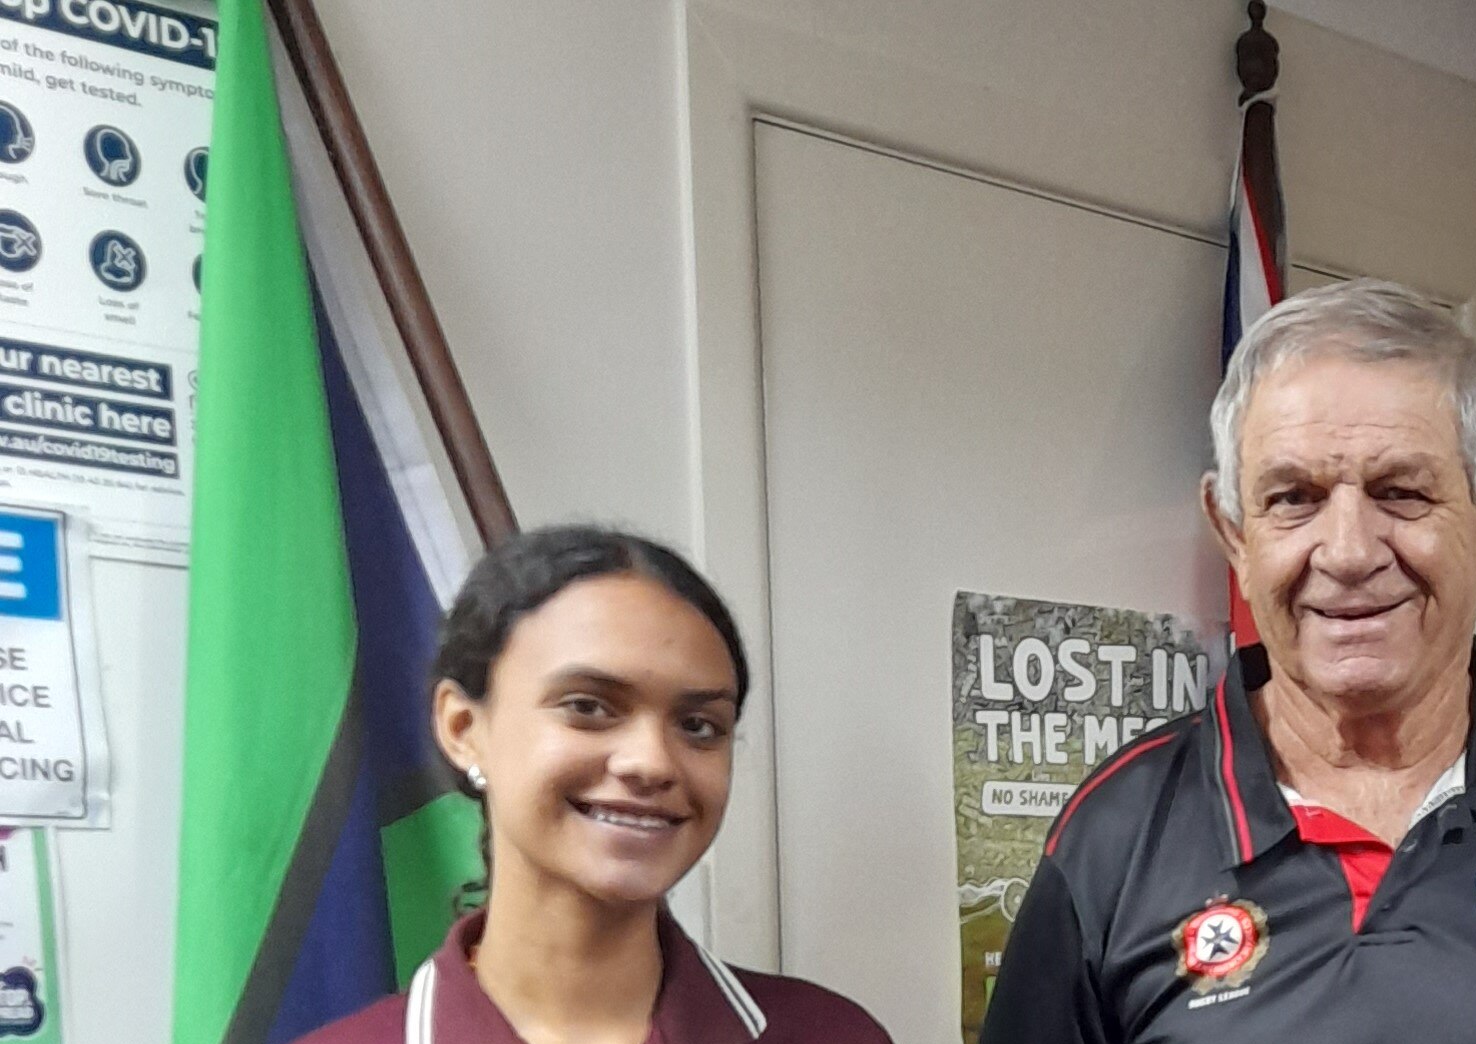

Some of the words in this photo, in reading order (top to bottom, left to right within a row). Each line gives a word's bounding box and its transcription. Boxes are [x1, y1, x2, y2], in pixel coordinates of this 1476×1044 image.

[1, 39, 19, 51] of
[24, 42, 55, 62] the
[61, 50, 145, 86] following
[45, 74, 75, 92] get
[81, 81, 143, 106] tested.
[40, 353, 163, 393] nearest
[3, 390, 95, 427] clinic
[97, 402, 172, 438] here
[979, 634, 1137, 708] LOST
[1152, 648, 1209, 713] IN
[975, 711, 1069, 765] THE
[991, 788, 1014, 805] NO
